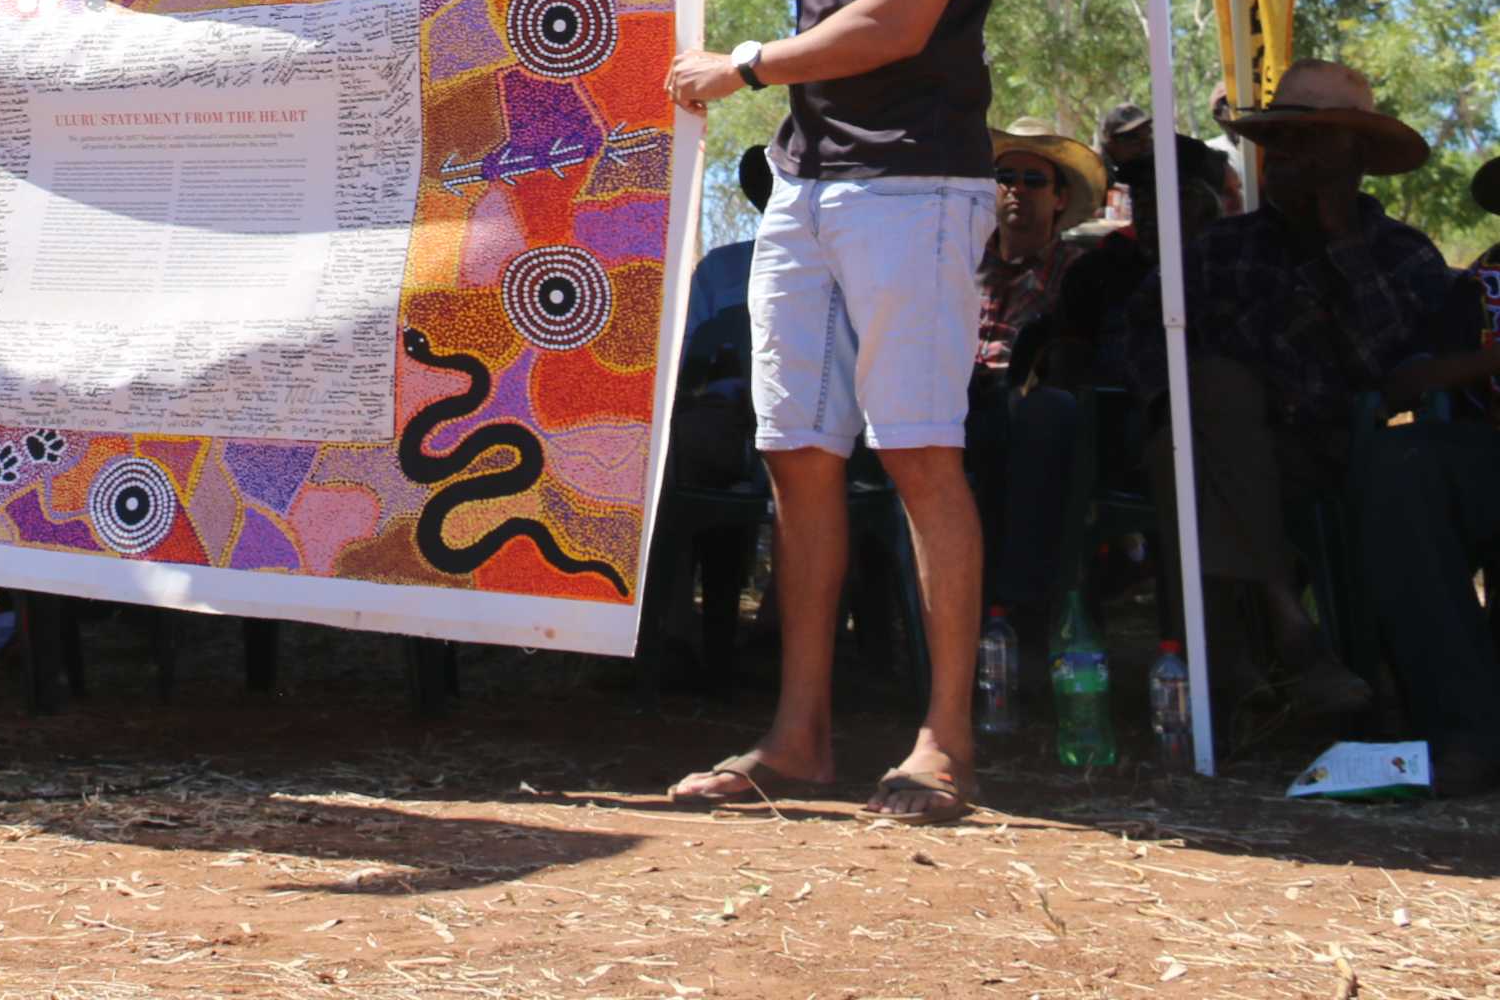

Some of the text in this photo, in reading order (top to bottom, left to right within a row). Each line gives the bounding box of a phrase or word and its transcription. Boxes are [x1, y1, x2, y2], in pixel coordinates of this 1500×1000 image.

[100, 111, 181, 126] STATEMENT
[184, 110, 223, 124] FROM
[226, 110, 255, 123] THE
[258, 109, 308, 123] HEART
